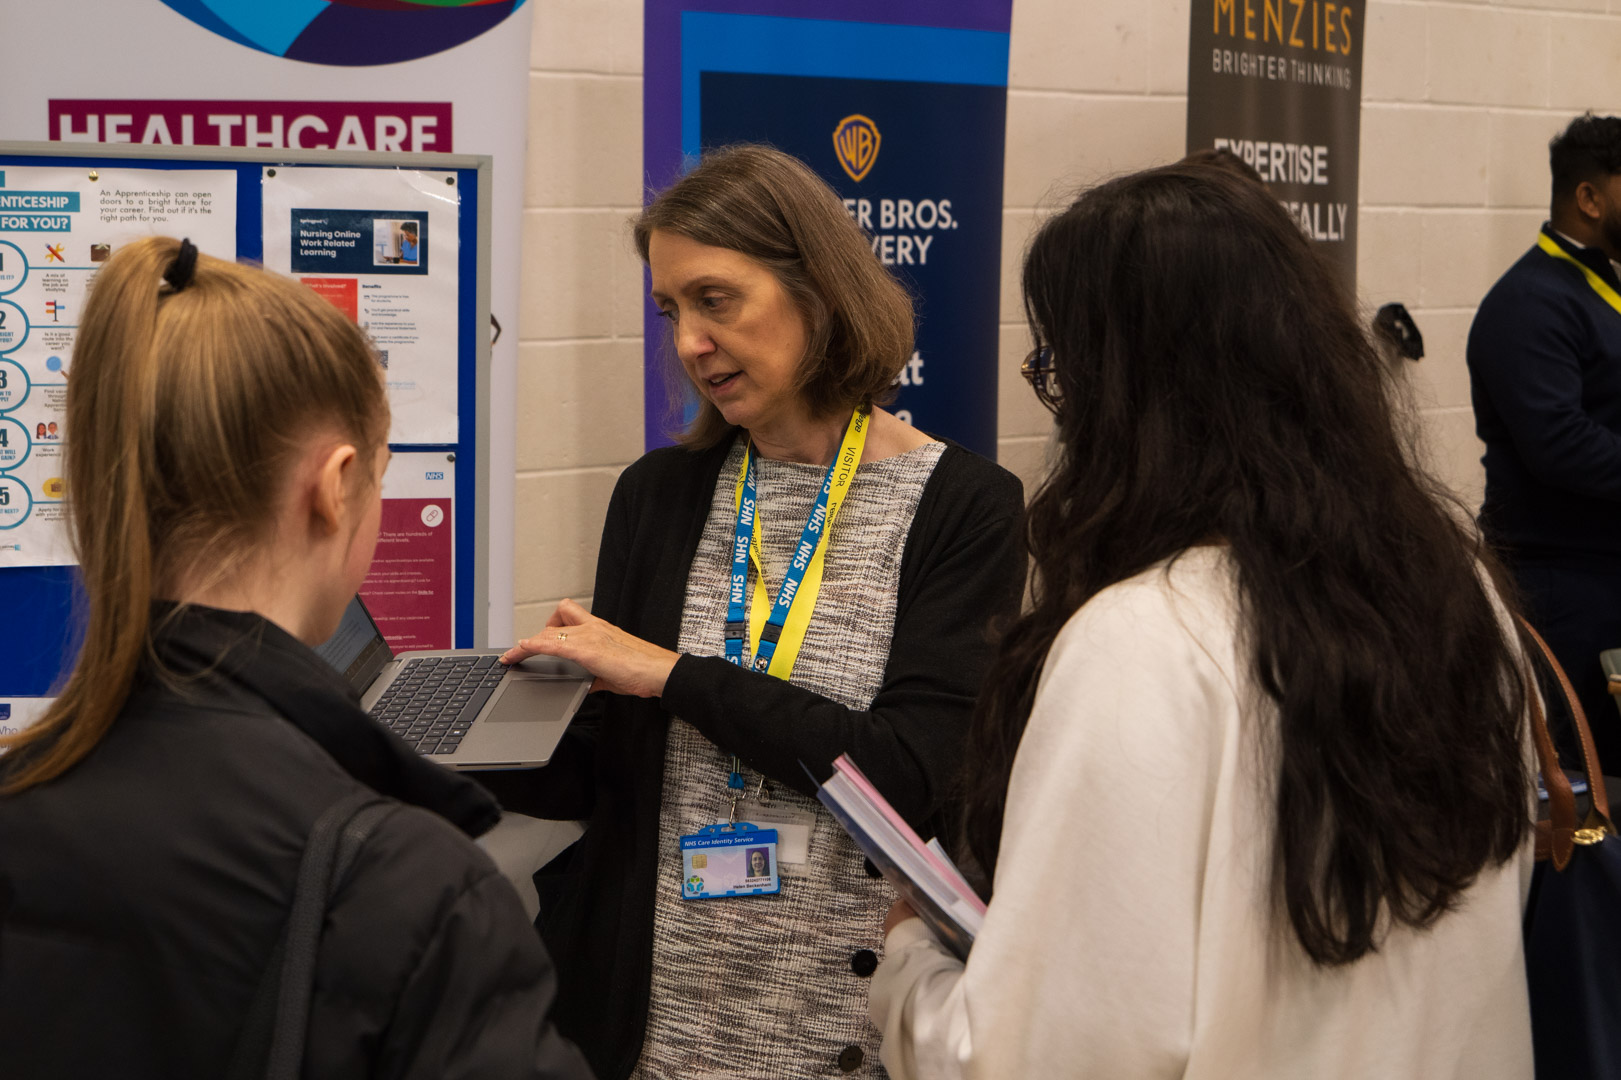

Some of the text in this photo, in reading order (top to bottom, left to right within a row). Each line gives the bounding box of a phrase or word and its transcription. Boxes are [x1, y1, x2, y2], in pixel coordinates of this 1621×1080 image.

[1213, 0, 1352, 56] MENZIES
[1212, 48, 1351, 90] BRIGHTER THINKING
[59, 114, 438, 152] HEALTHCARE
[1214, 138, 1328, 184] PERTISE
[0, 196, 69, 208] NTICESHIP
[115, 190, 171, 198] Apprenticeship
[148, 198, 170, 206] bright
[1, 216, 68, 229] FOR YOU?
[100, 215, 118, 223] right
[120, 215, 137, 223] path
[880, 200, 958, 229] BROS.
[1281, 201, 1348, 241] ALLY
[300, 230, 361, 239] Nursing Online
[300, 248, 336, 258] Learning
[872, 235, 932, 265] ERY
[836, 447, 856, 487] VISITOR
[741, 497, 755, 525] NHS
[808, 504, 827, 534] NHS
[735, 536, 749, 564] NHS
[794, 540, 813, 571] NHS
[732, 574, 745, 604] NHS
[778, 577, 798, 608] NHS
